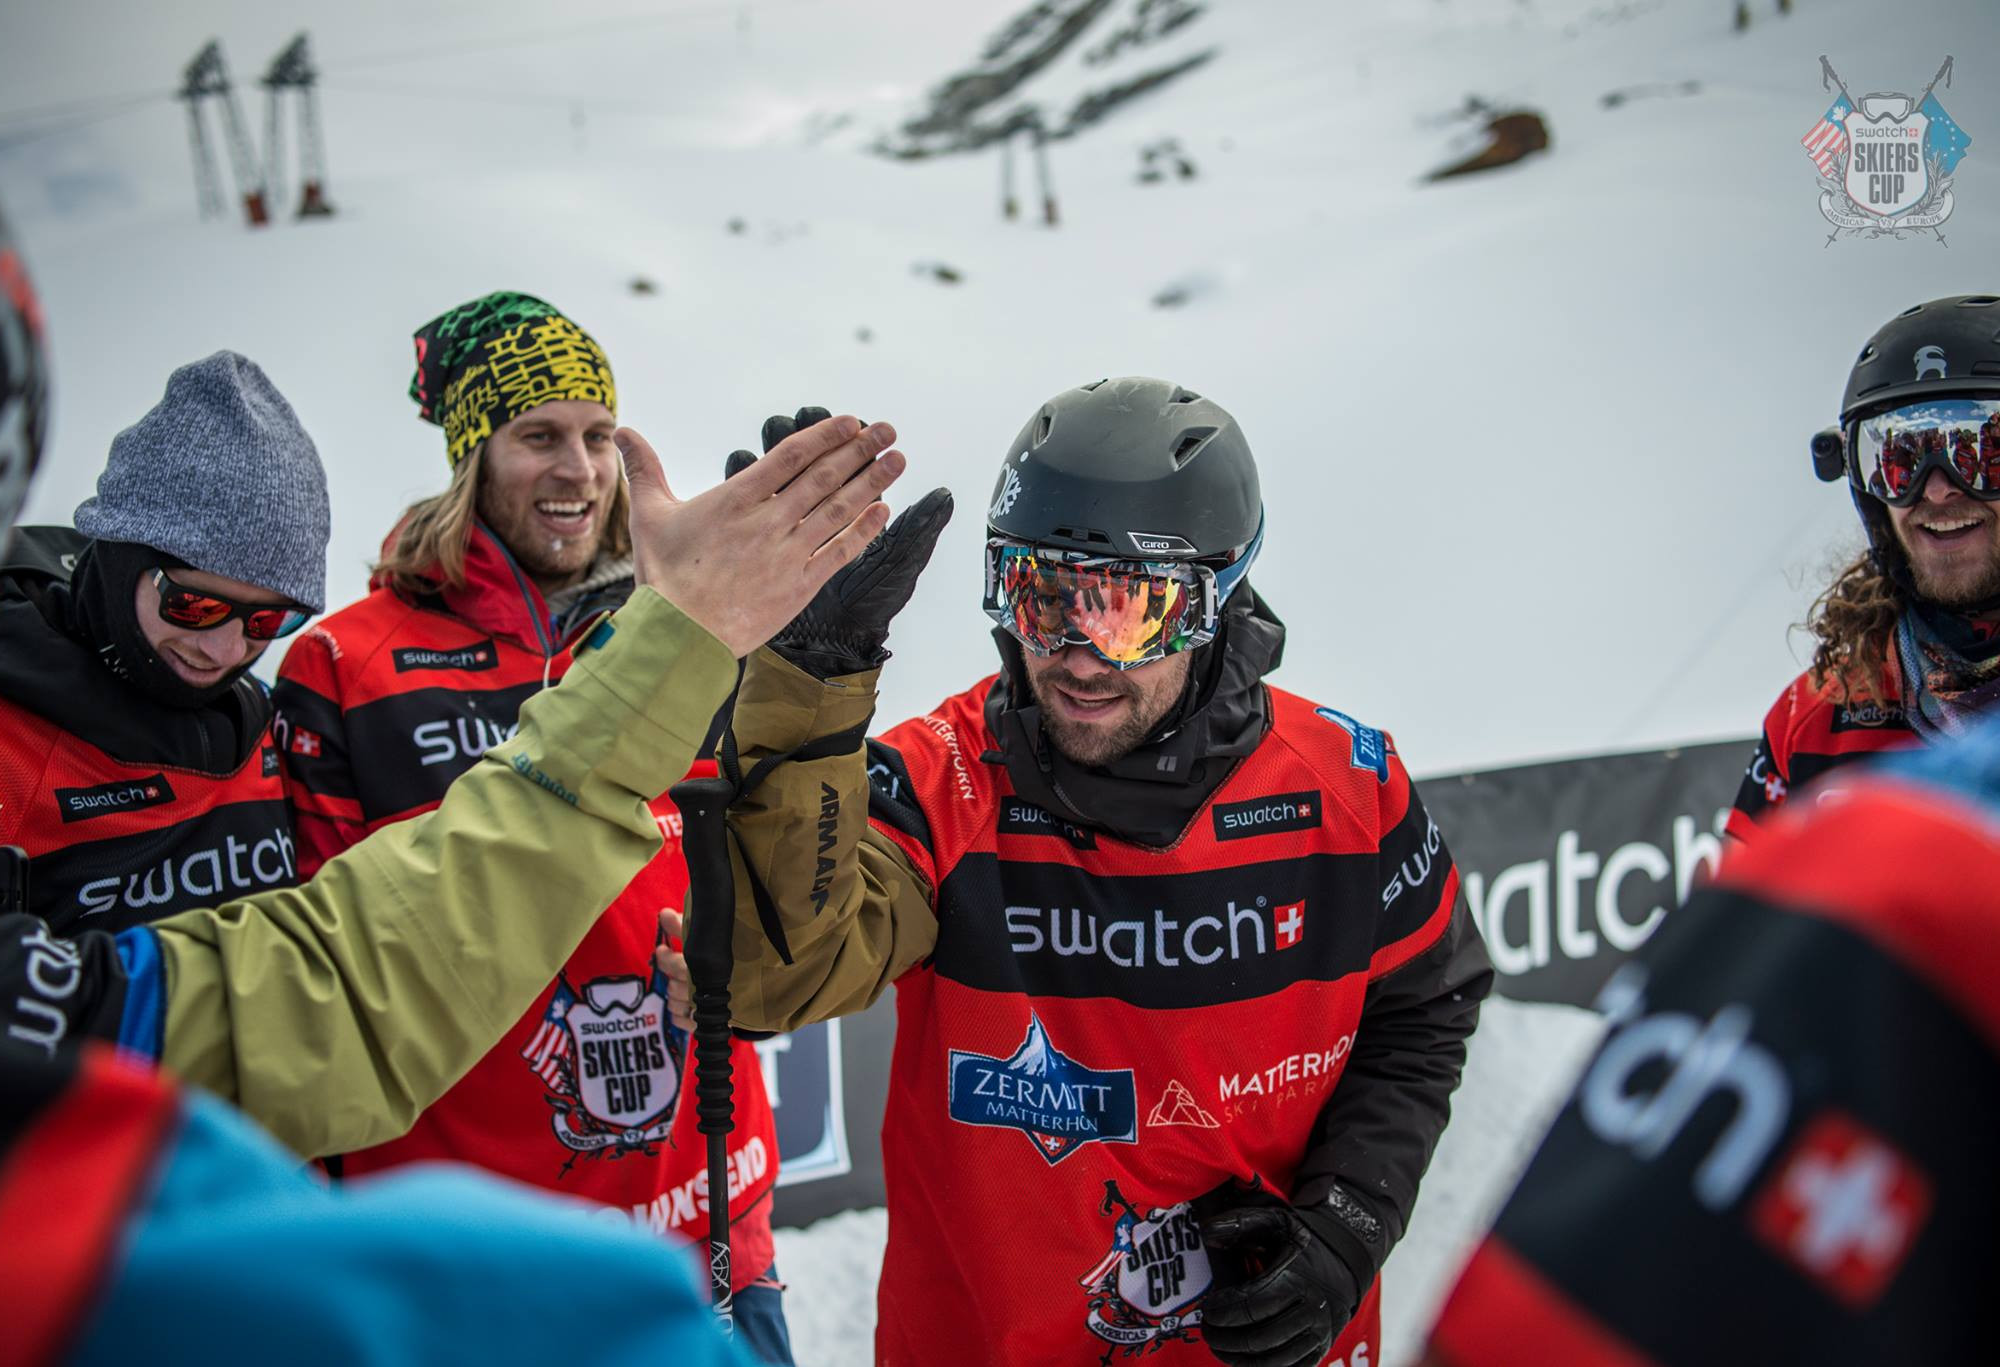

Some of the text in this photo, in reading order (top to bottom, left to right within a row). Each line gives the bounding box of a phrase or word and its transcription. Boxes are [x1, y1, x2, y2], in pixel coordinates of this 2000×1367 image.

[1141, 541, 1170, 549] GIRO
[69, 786, 146, 811] swatch
[1223, 792, 1297, 829] swatch
[78, 828, 296, 919] swatch
[580, 1015, 646, 1036] swatch
[581, 1031, 666, 1079] SKIERS
[604, 1073, 652, 1116] CUP
